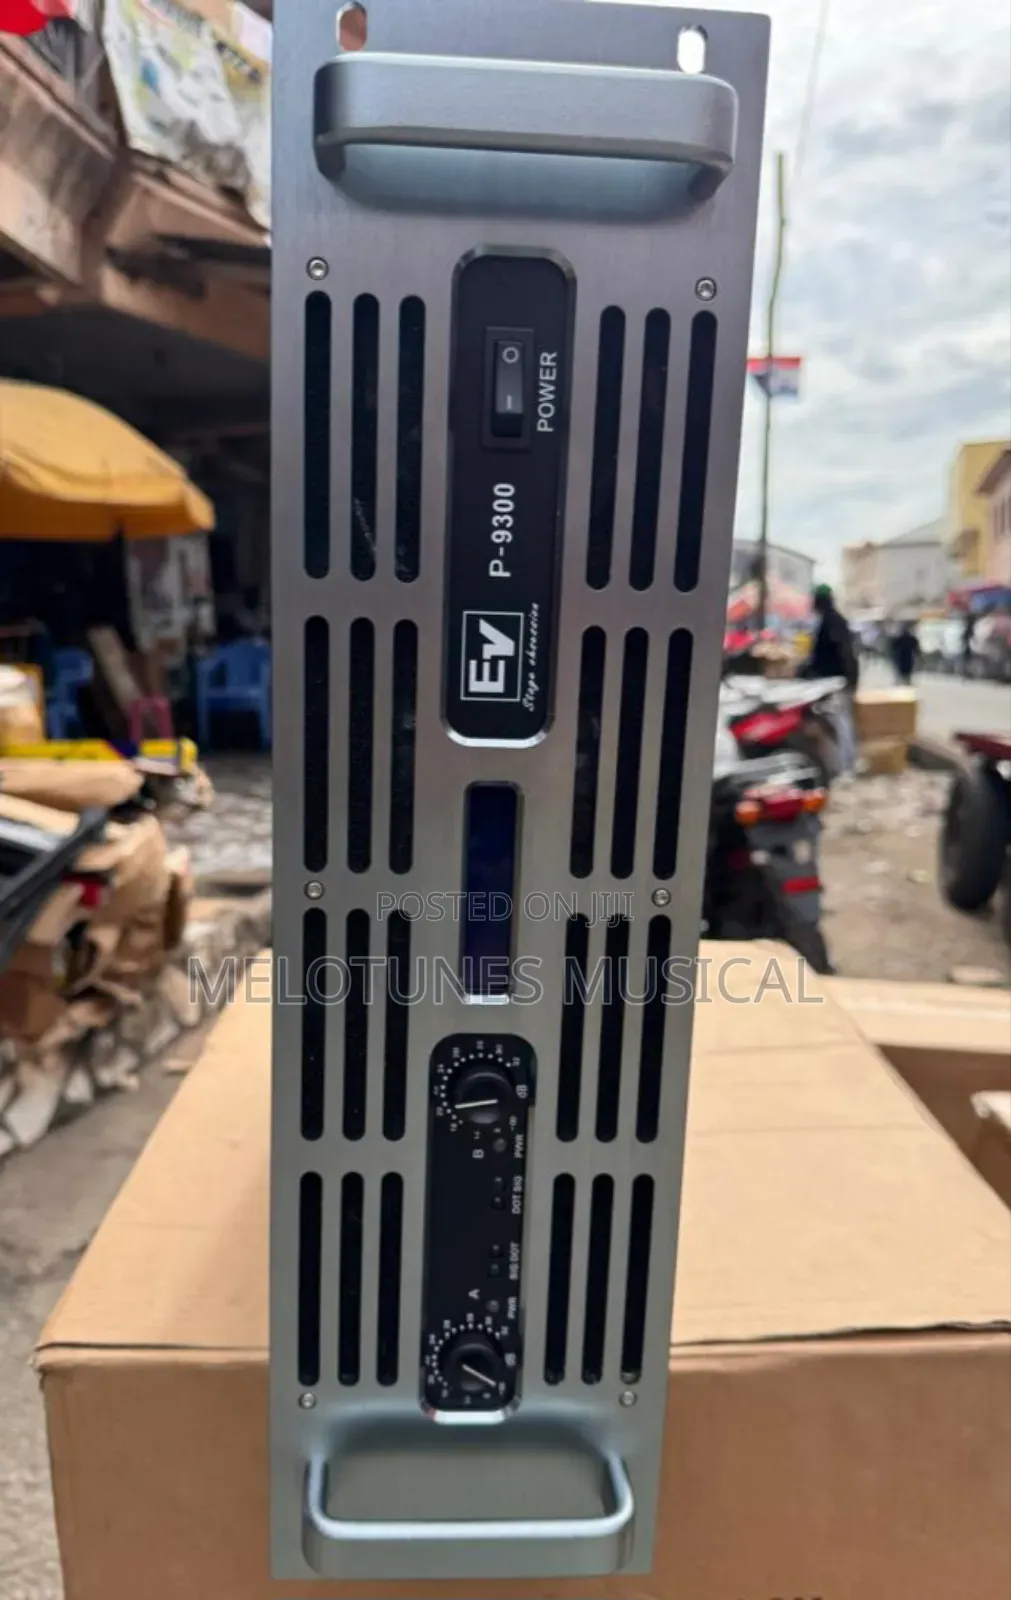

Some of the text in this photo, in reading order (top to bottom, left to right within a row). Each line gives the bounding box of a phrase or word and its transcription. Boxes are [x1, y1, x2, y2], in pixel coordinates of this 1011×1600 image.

[536, 352, 558, 433] POWER
[488, 483, 516, 578] P-9300
[472, 1148, 485, 1159] B
[513, 1133, 524, 1159] PWR
[467, 1288, 480, 1300] A
[507, 1296, 517, 1319] PWR
